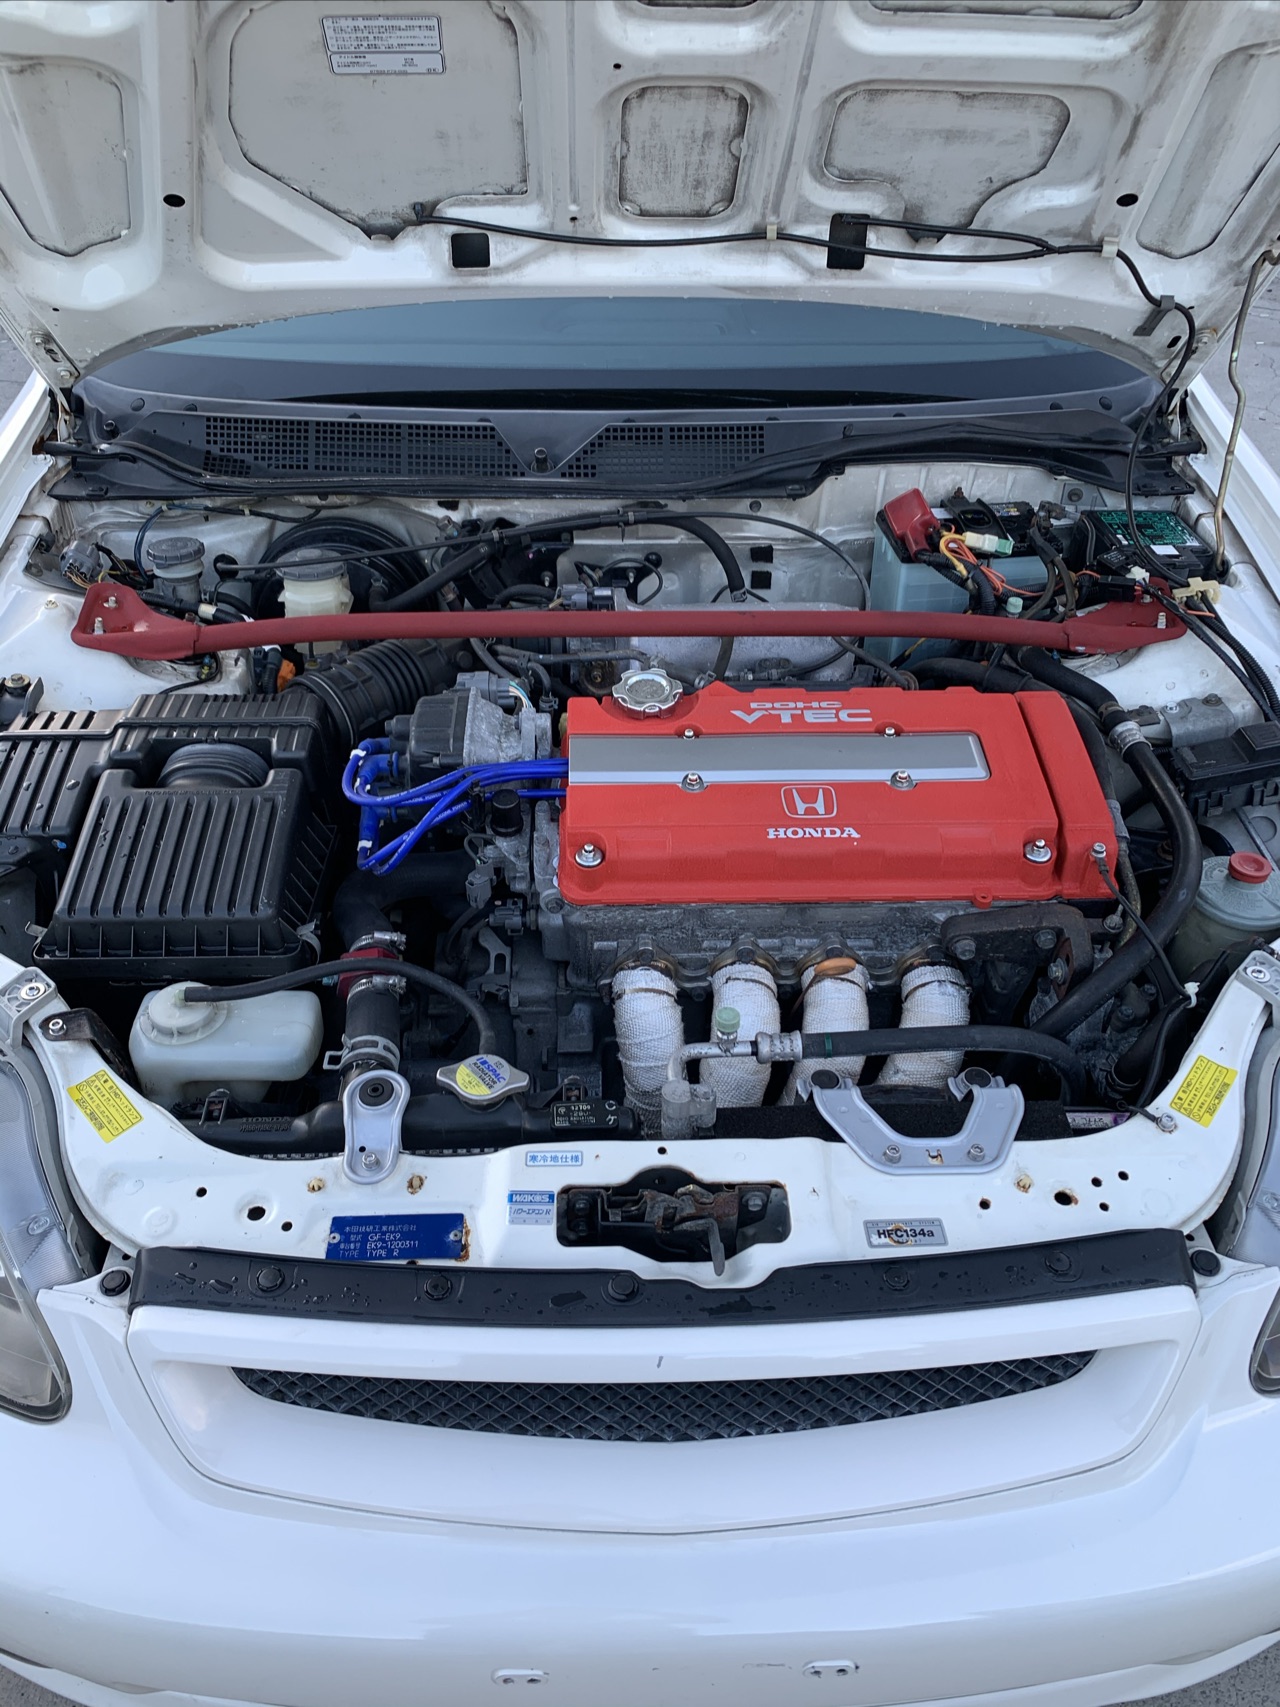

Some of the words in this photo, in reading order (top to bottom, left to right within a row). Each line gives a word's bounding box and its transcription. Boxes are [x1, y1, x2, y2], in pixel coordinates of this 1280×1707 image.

[750, 701, 842, 709] DOHC
[730, 709, 873, 724] VTEC
[766, 827, 861, 839] HONDA
[472, 1061, 498, 1086] RADIATOR
[478, 1074, 495, 1090] VALVE
[528, 1154, 580, 1164] 寒冷地仕様
[368, 1232, 401, 1241] GF-EK9
[876, 1227, 935, 1239] HFC134a
[366, 1240, 419, 1250] EK9-1200311
[339, 1249, 360, 1258] TYPE
[366, 1248, 388, 1258] TYPE
[393, 1248, 400, 1257] R
